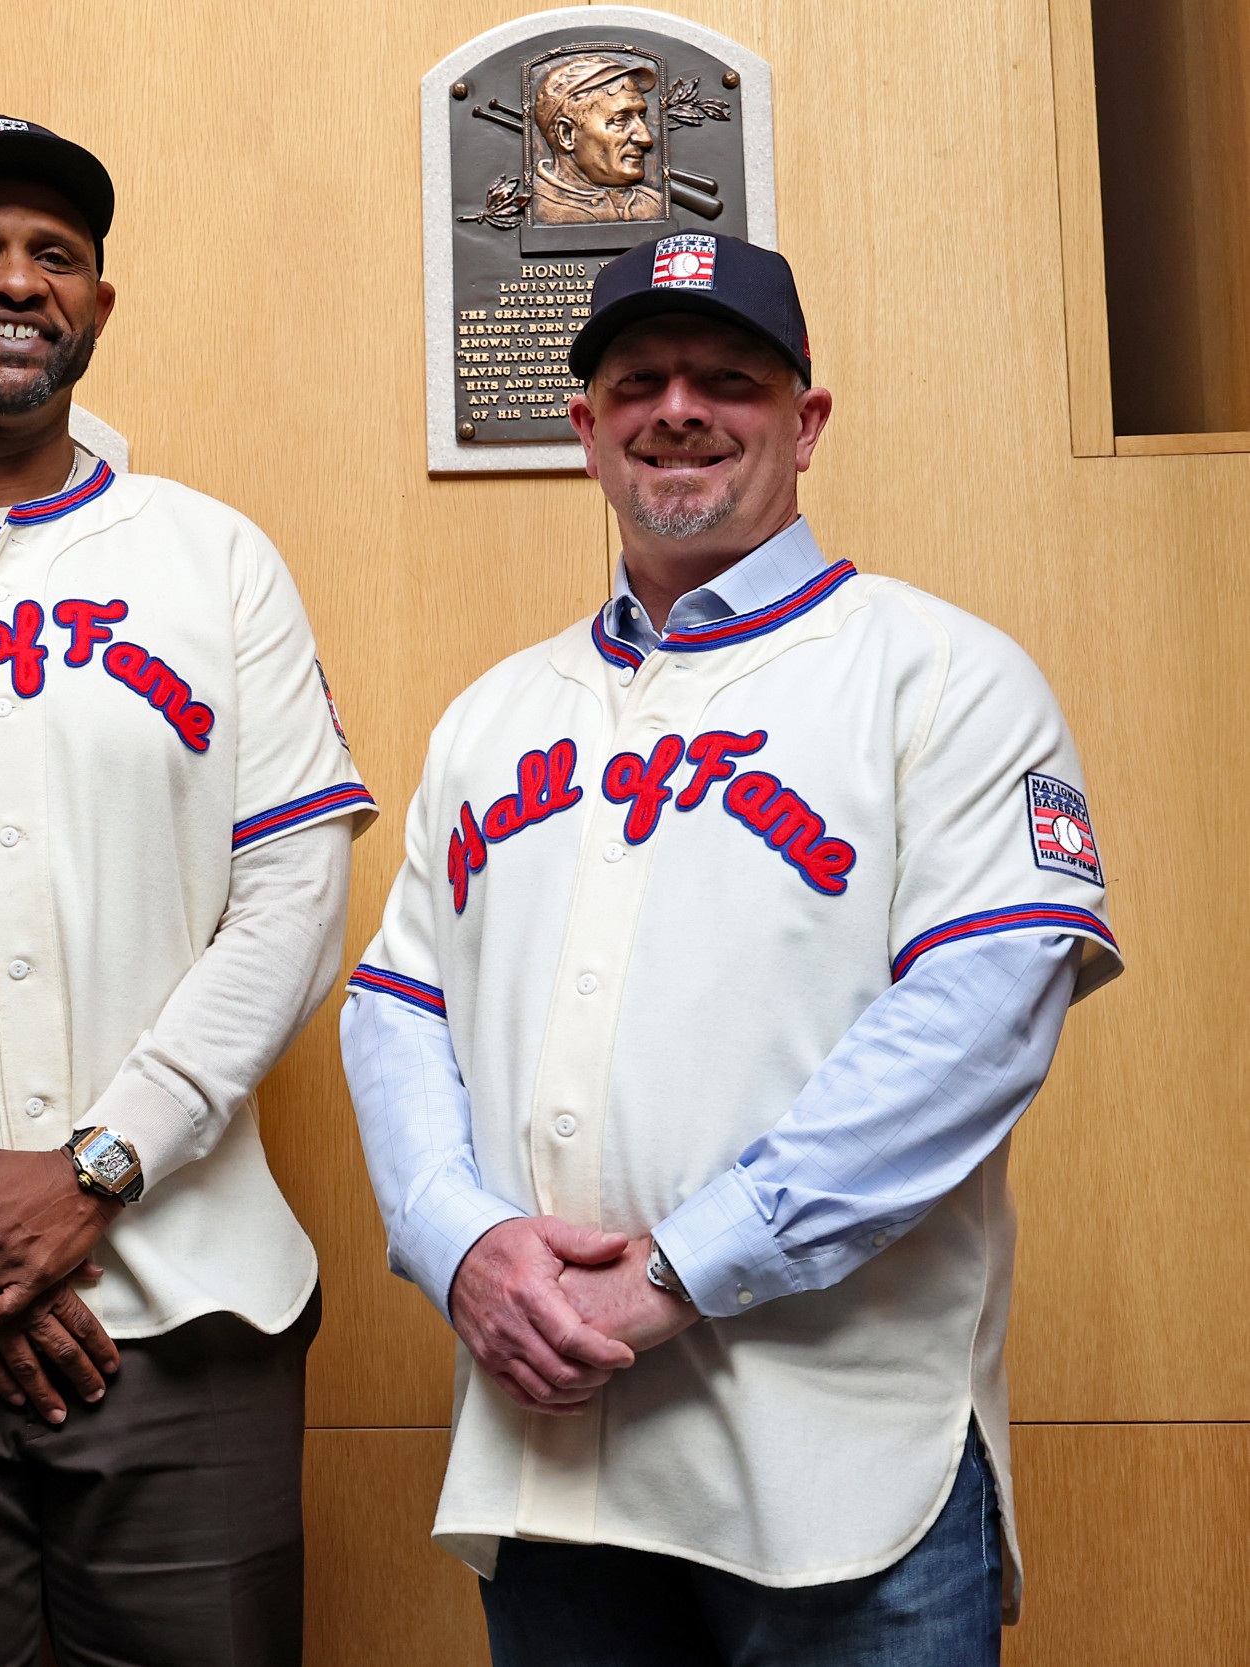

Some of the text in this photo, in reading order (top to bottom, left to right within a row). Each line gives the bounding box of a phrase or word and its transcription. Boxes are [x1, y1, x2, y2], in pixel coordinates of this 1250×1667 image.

[659, 235, 714, 245] NATIONAL
[521, 264, 586, 278] HONUS
[499, 281, 594, 292] LOUISVILLE
[460, 308, 592, 320] THE GREATEST SH
[459, 324, 525, 335] HISTORY.
[529, 323, 563, 333] BORN
[460, 337, 573, 348] KNOWN TO FAME
[457, 350, 570, 362] "THE FLYING DU
[459, 365, 570, 377] HAVING SCORED
[466, 381, 499, 391] HITS
[504, 379, 533, 389] AND
[469, 395, 499, 405] ANY
[508, 393, 554, 403] OTHER
[472, 408, 570, 419] OF HIS LEAG
[53, 599, 215, 753] Fame
[1032, 779, 1084, 805] NATIONAL
[1034, 798, 1088, 825] BASEBALL
[448, 730, 856, 914] Hall of Fame
[1040, 850, 1098, 874] HALL OF FAME
